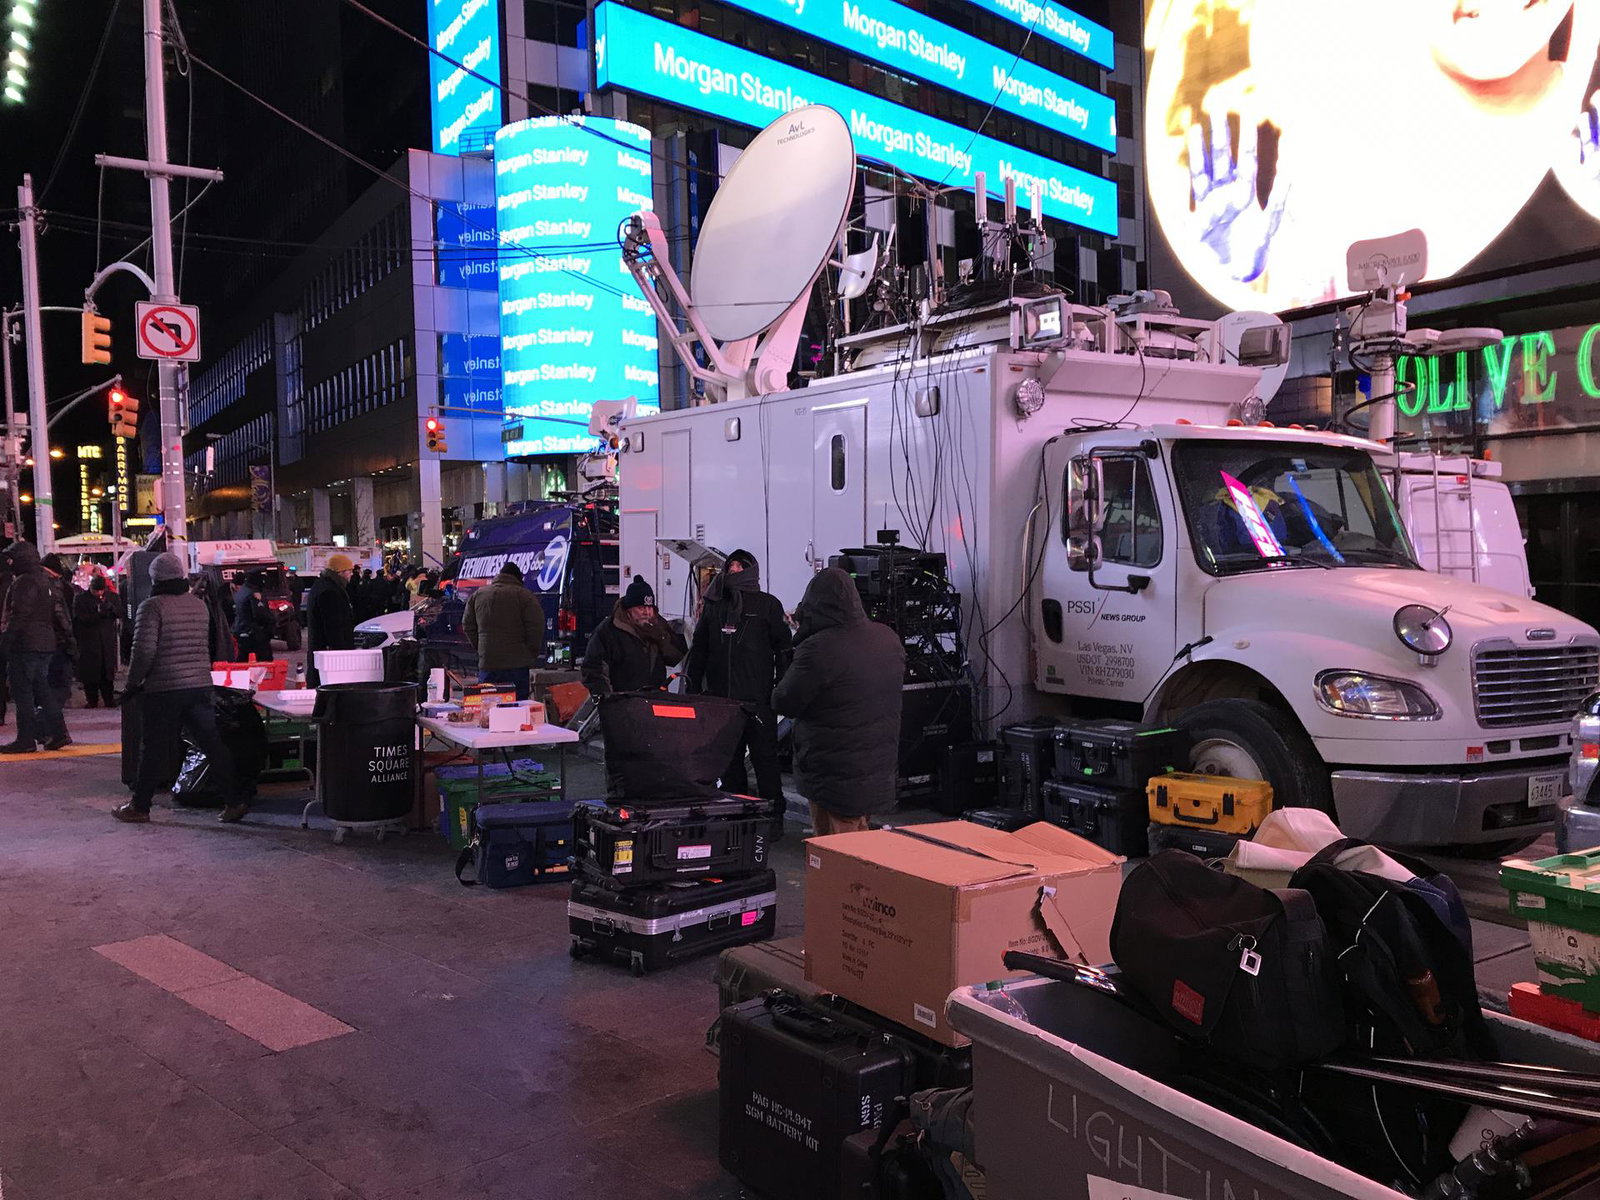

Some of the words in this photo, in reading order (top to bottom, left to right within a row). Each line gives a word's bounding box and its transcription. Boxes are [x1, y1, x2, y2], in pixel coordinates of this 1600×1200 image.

[1045, 7, 1090, 51] Stanley
[844, 2, 906, 50] Morgan
[908, 30, 965, 78] Stanley
[655, 43, 737, 96] Morgan
[741, 72, 814, 111] Stanle
[993, 66, 1042, 106] Morgan
[1044, 88, 1088, 129] Stanley
[851, 110, 913, 152] Morgan
[915, 132, 971, 176] Stanley
[533, 147, 588, 166] Stanley
[533, 183, 588, 202] Stanley
[1049, 178, 1094, 215] Stanley
[535, 219, 591, 238] Stanley
[535, 255, 591, 274] Stanley
[537, 291, 594, 310] Stanley
[538, 327, 593, 346] Stanley
[540, 363, 596, 382] Stanley
[1396, 331, 1558, 416] OLIVE
[116, 436, 127, 510] BARRYMORE
[530, 559, 545, 571] abc
[1067, 600, 1095, 614] PSSI
[1100, 613, 1120, 622] NEWS
[1121, 614, 1146, 622] GROUP
[1078, 641, 1091, 651] Las
[1120, 643, 1134, 654] NV
[1076, 654, 1101, 665] USDOT
[1080, 664, 1094, 675] VIN
[373, 744, 408, 758] TIMES
[368, 757, 410, 773] SQUARE
[370, 770, 408, 783] ALLIANCE
[754, 834, 765, 863] CNN
[752, 1091, 769, 1109] PAG
[745, 1103, 764, 1123] SGM
[766, 1115, 803, 1142] BATTERY
[805, 1134, 820, 1152] KIT
